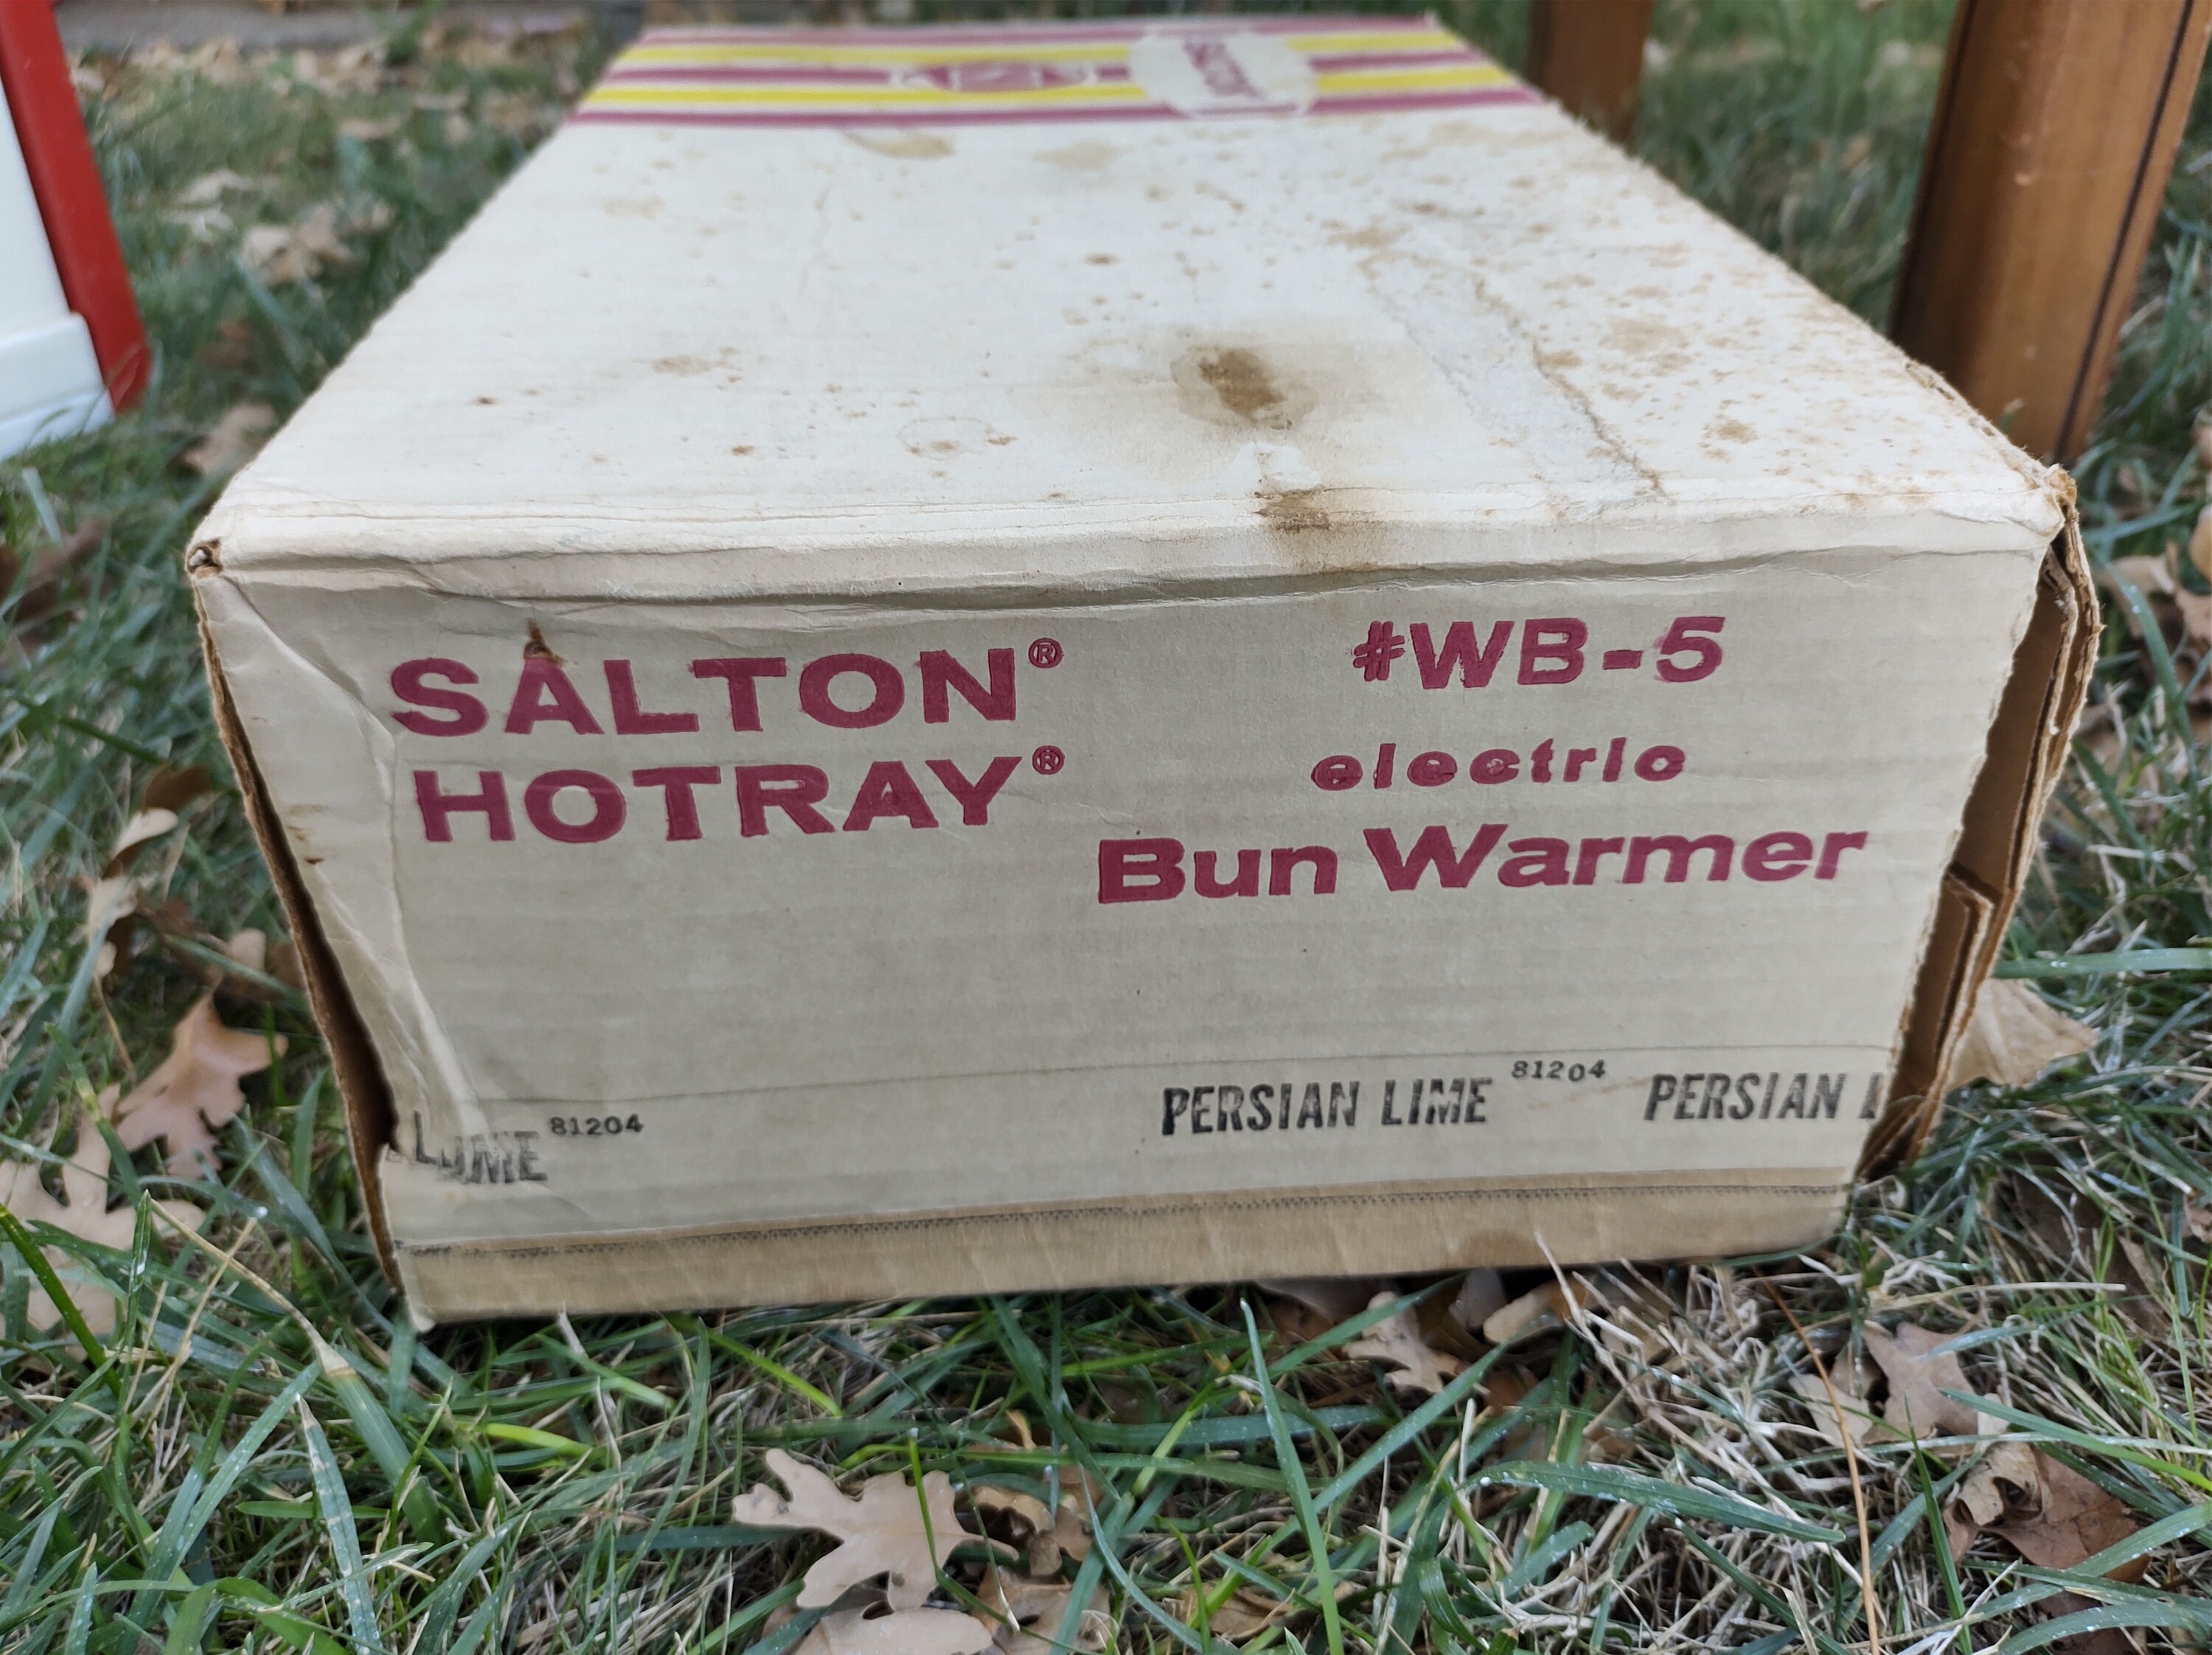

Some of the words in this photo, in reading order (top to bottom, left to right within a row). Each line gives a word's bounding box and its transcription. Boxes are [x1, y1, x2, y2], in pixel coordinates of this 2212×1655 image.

[1353, 616, 1726, 689] #WB-5
[1098, 835, 1338, 904] Bun
[1363, 823, 1869, 891] Warmer
[550, 1113, 644, 1136] 81204
[1161, 1080, 1360, 1136] PERSIAN
[1380, 1077, 1493, 1126] LIME
[1511, 1060, 1606, 1082] 81204
[1644, 1072, 1846, 1121] PERSIAN
